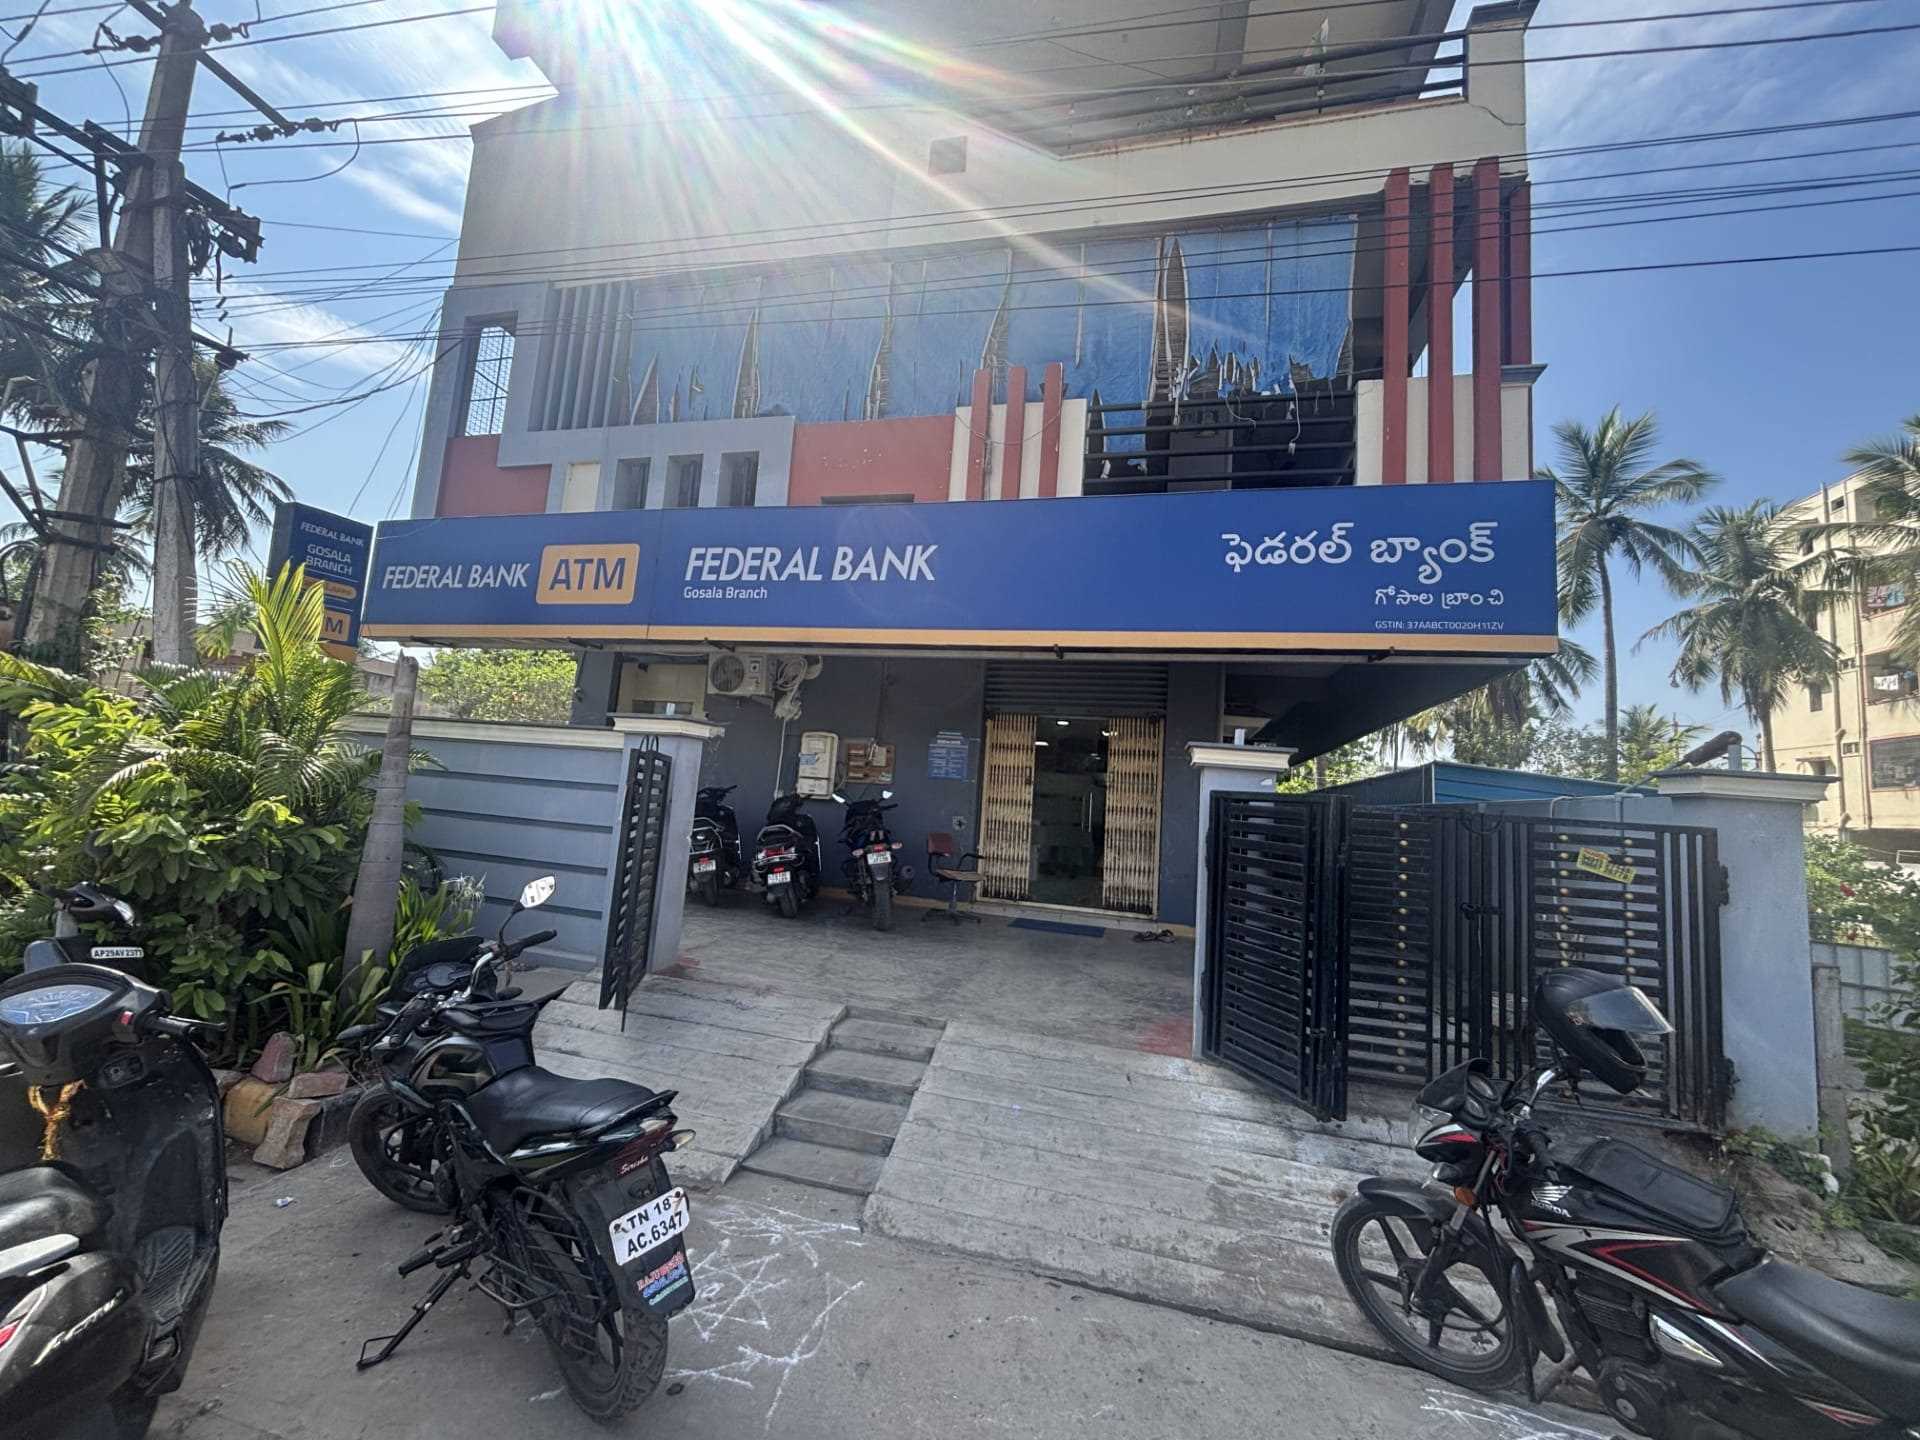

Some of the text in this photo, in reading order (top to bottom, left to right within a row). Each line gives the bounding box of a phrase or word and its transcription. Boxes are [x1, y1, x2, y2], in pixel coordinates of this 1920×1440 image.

[301, 521, 364, 547] FEDERAL BANK
[306, 555, 352, 575] BRANCH
[307, 544, 351, 563] GOSALA
[684, 545, 939, 581] FEDERAL BANK
[1221, 521, 1498, 584] ఫెడరల్ బ్యాంక్
[382, 565, 463, 589] FEDERAL
[467, 563, 531, 588] BANK
[549, 558, 626, 591] ATM
[684, 586, 768, 599] Gosala Branch
[627, 1198, 672, 1230] TN 18
[627, 1211, 684, 1257] AC.6347
